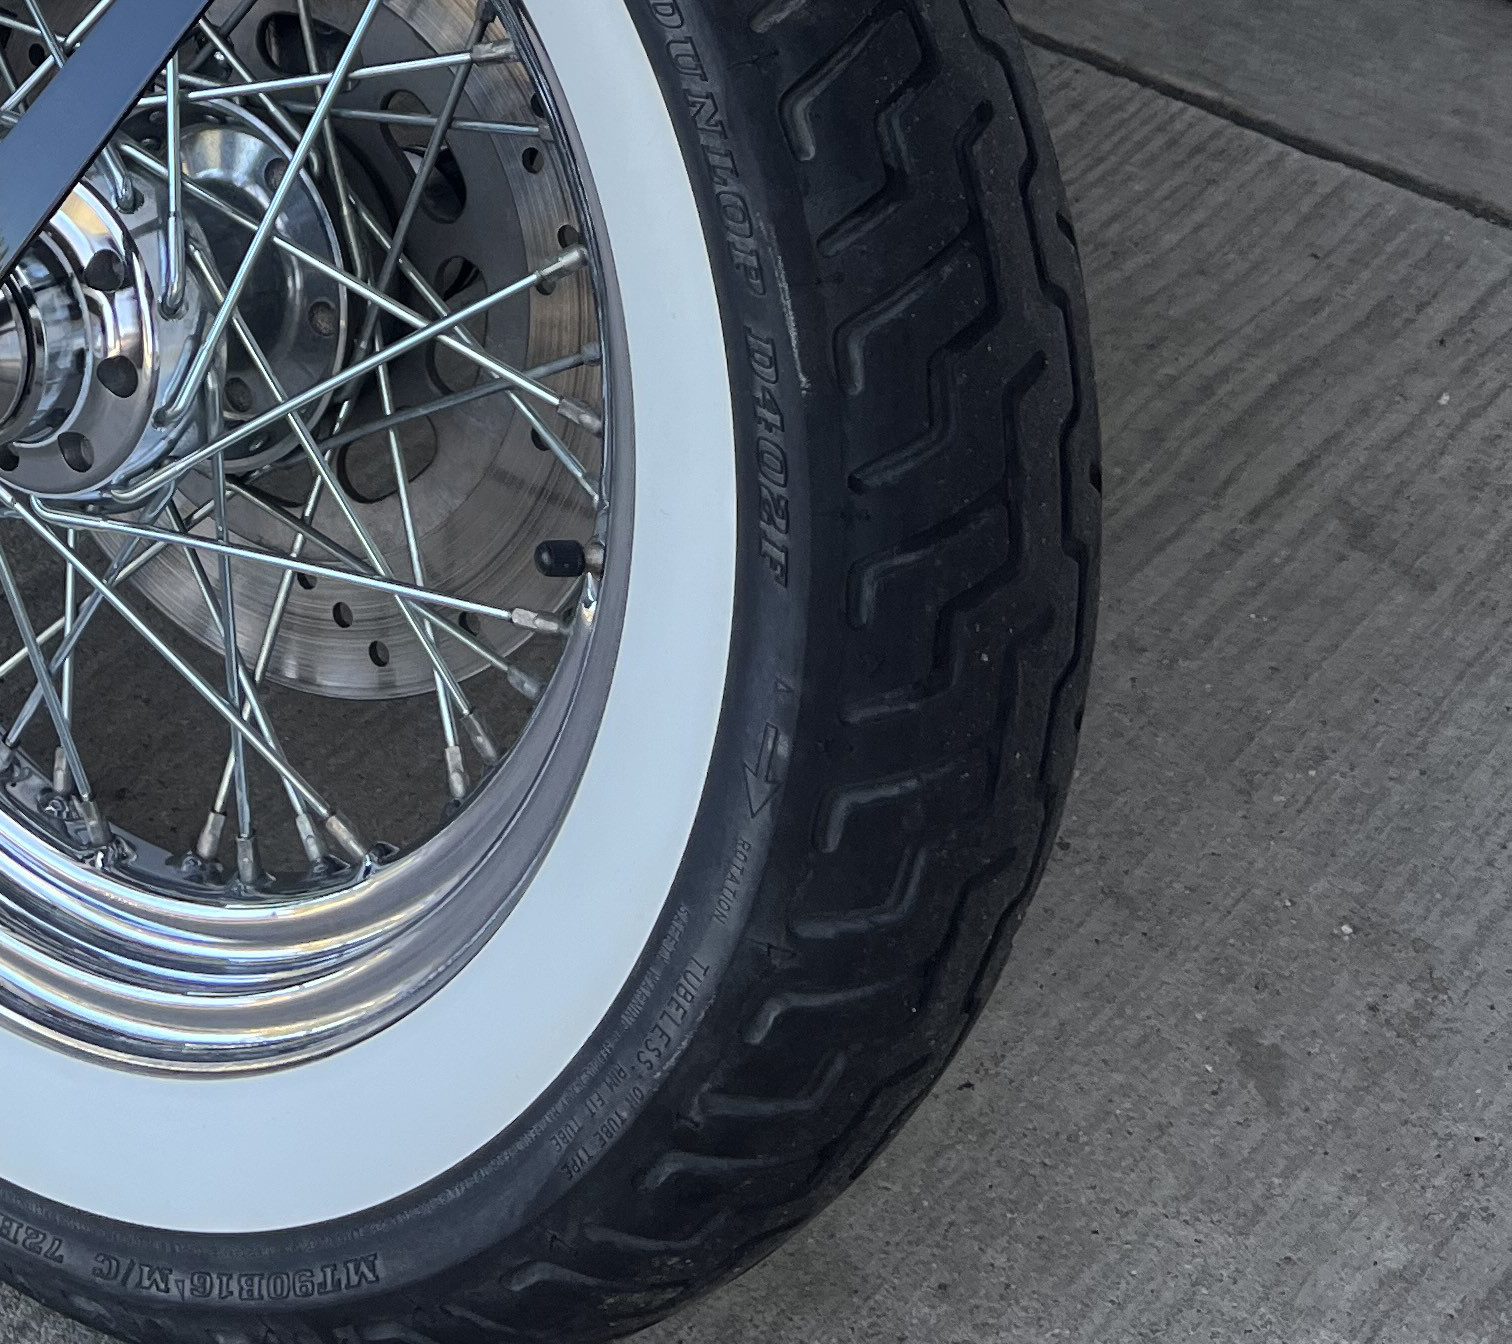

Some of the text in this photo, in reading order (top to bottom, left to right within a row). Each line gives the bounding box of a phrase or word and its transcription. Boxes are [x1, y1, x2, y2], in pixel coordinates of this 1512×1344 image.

[744, 326, 789, 590] D402F
[711, 838, 752, 926] ROTATION
[586, 1090, 608, 1119] FIT
[551, 1116, 583, 1154] TUBE
[592, 1109, 629, 1149] TUBE
[559, 1145, 594, 1182] TYPE
[91, 1251, 175, 1294] M/C
[190, 1252, 381, 1302] MT90B16
